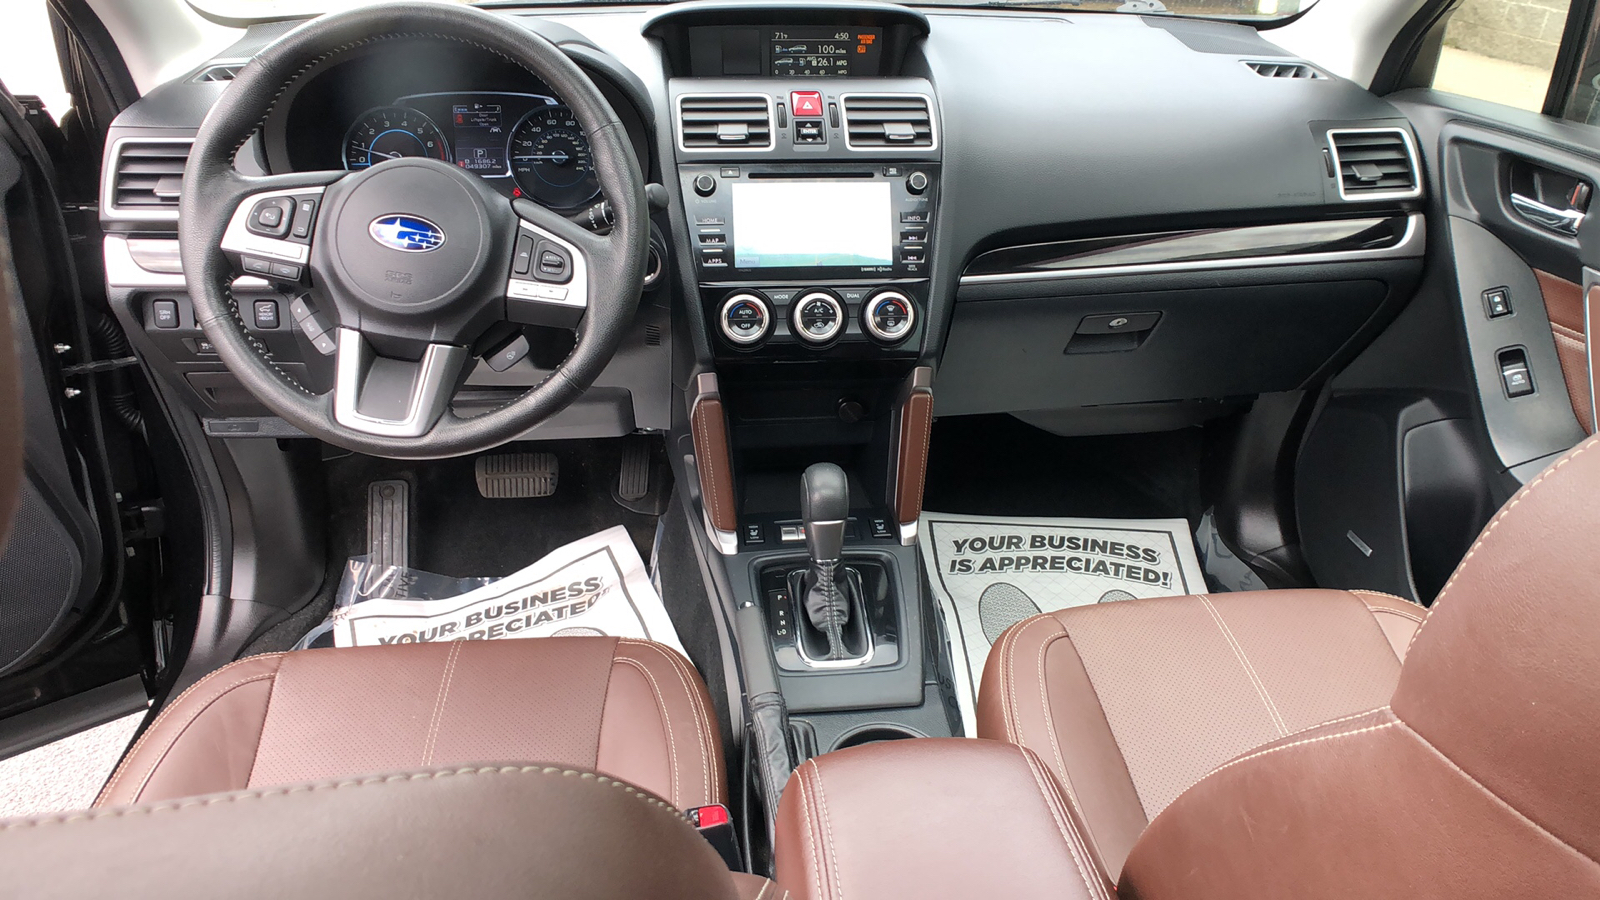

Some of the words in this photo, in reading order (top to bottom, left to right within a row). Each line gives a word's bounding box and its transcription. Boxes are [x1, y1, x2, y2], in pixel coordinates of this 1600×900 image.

[817, 45, 834, 54] 100
[818, 58, 833, 66] 26.1
[477, 150, 484, 158] P
[952, 535, 1024, 553] YOUR
[1029, 535, 1159, 564] BUSINESS
[950, 558, 973, 573] IS
[978, 555, 1171, 586] APPRECIATED!
[377, 621, 458, 645] YOUR
[465, 576, 601, 629] BUSINESS
